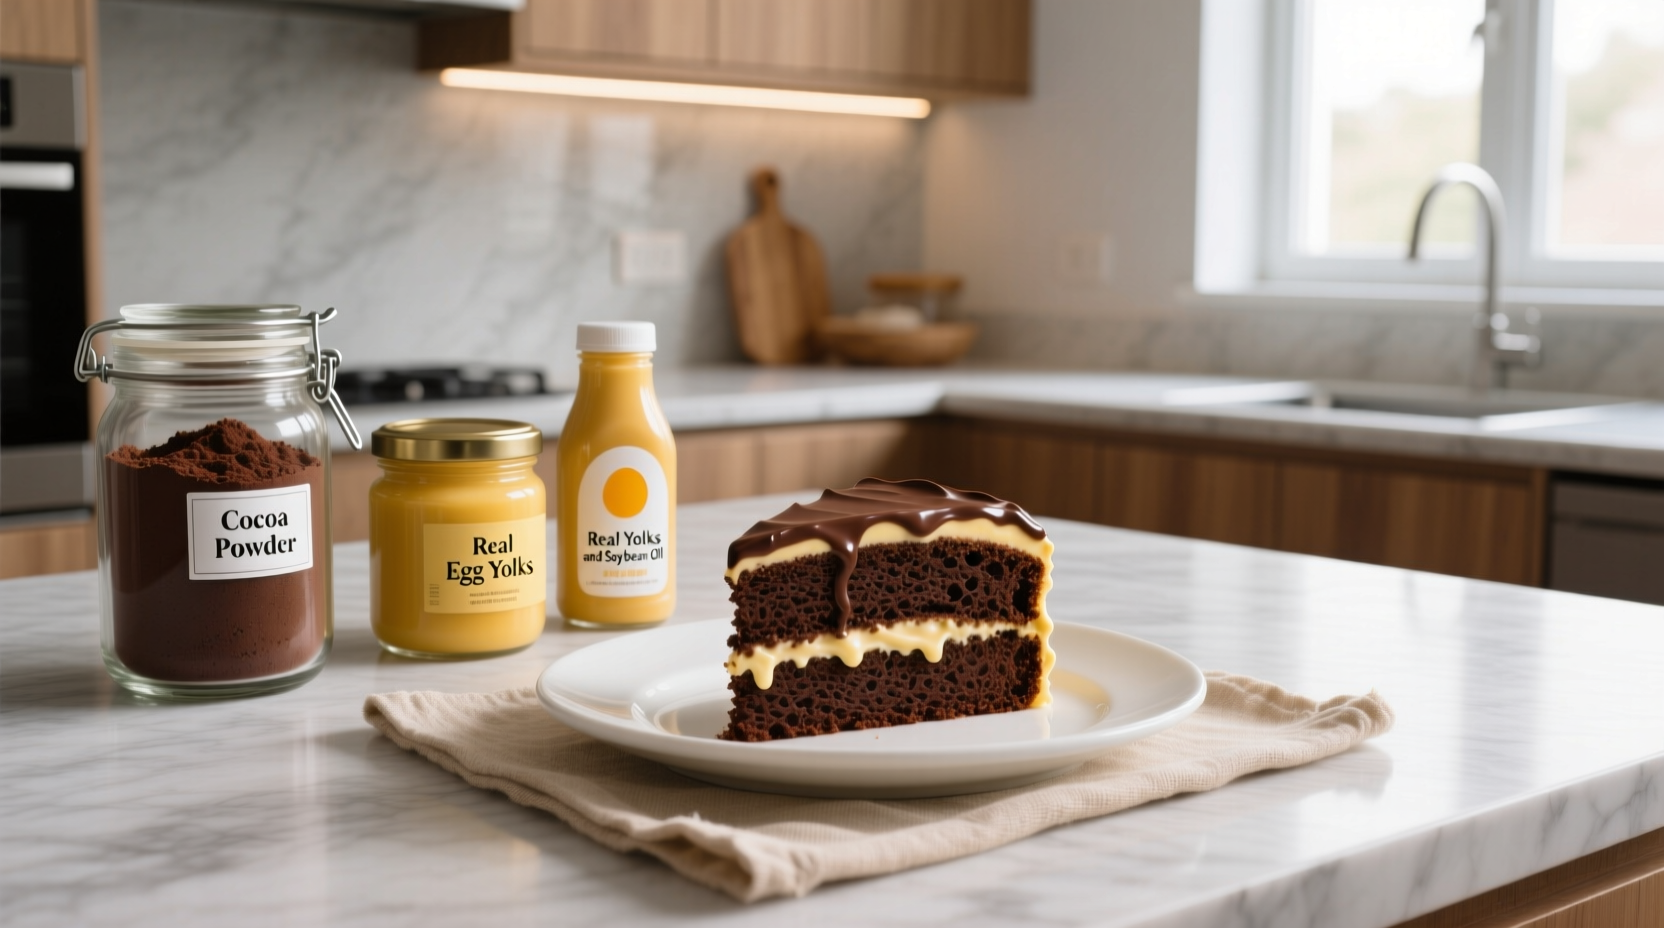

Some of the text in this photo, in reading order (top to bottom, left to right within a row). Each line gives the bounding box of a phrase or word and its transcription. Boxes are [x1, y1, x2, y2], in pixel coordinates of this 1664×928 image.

[221, 509, 288, 531] Cocoa
[215, 534, 297, 559] Powder
[473, 533, 513, 555] Real
[588, 529, 662, 546] Real Yolks
[583, 550, 603, 562] and
[605, 549, 648, 565] Soybean
[446, 556, 534, 587] Egg Yolks
